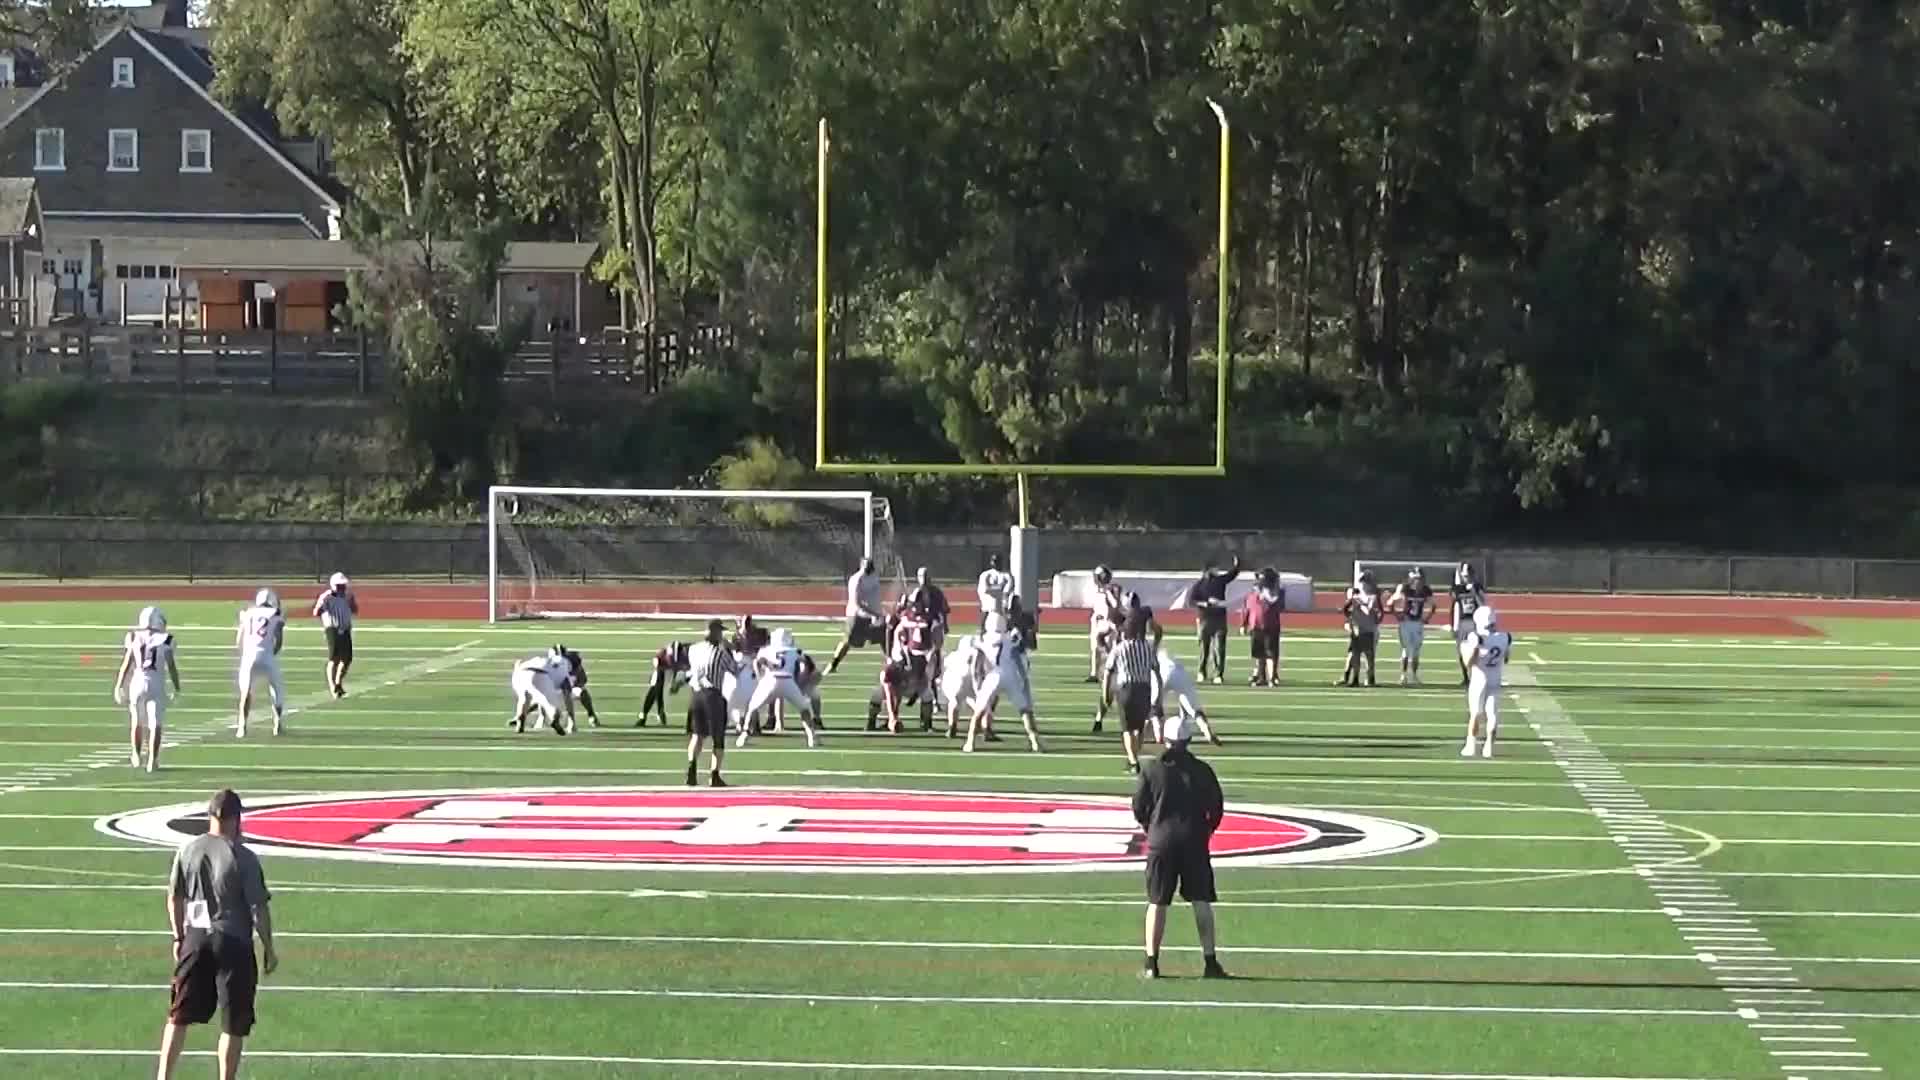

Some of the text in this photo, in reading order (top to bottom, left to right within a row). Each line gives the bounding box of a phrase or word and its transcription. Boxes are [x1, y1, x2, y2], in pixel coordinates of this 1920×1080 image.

[249, 617, 269, 638] 12
[775, 651, 787, 670] 5
[1485, 646, 1501, 668] 2
